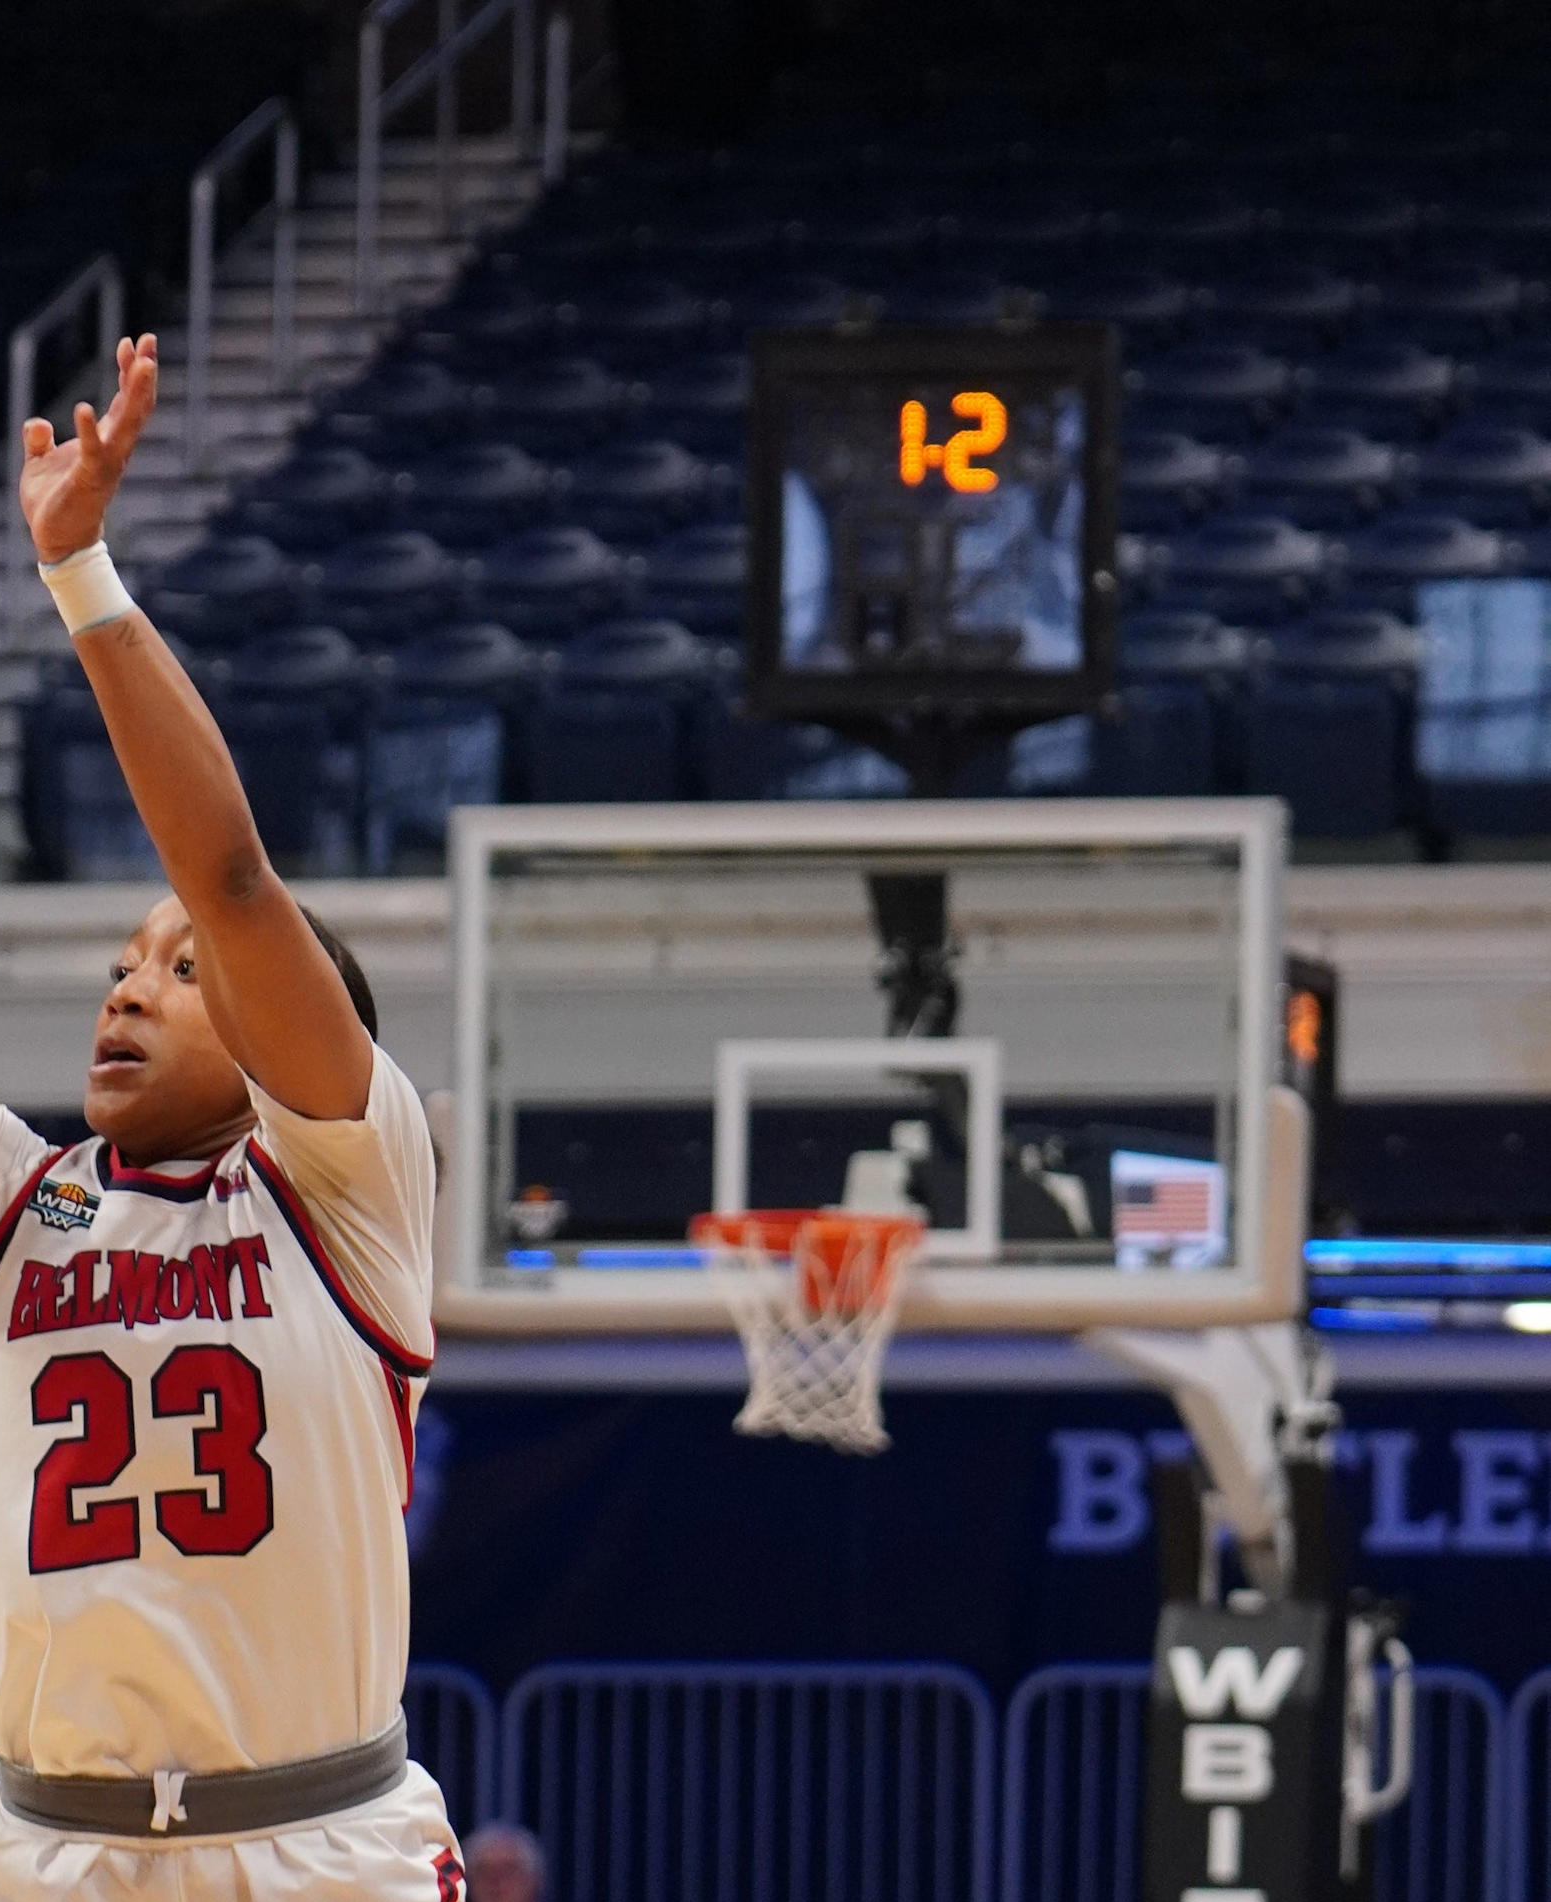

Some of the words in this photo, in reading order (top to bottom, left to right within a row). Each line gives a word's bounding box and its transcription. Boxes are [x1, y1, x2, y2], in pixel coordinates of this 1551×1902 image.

[36, 1188, 98, 1222] WBIT
[7, 1233, 273, 1343] BELMONT
[28, 1343, 275, 1577] 23
